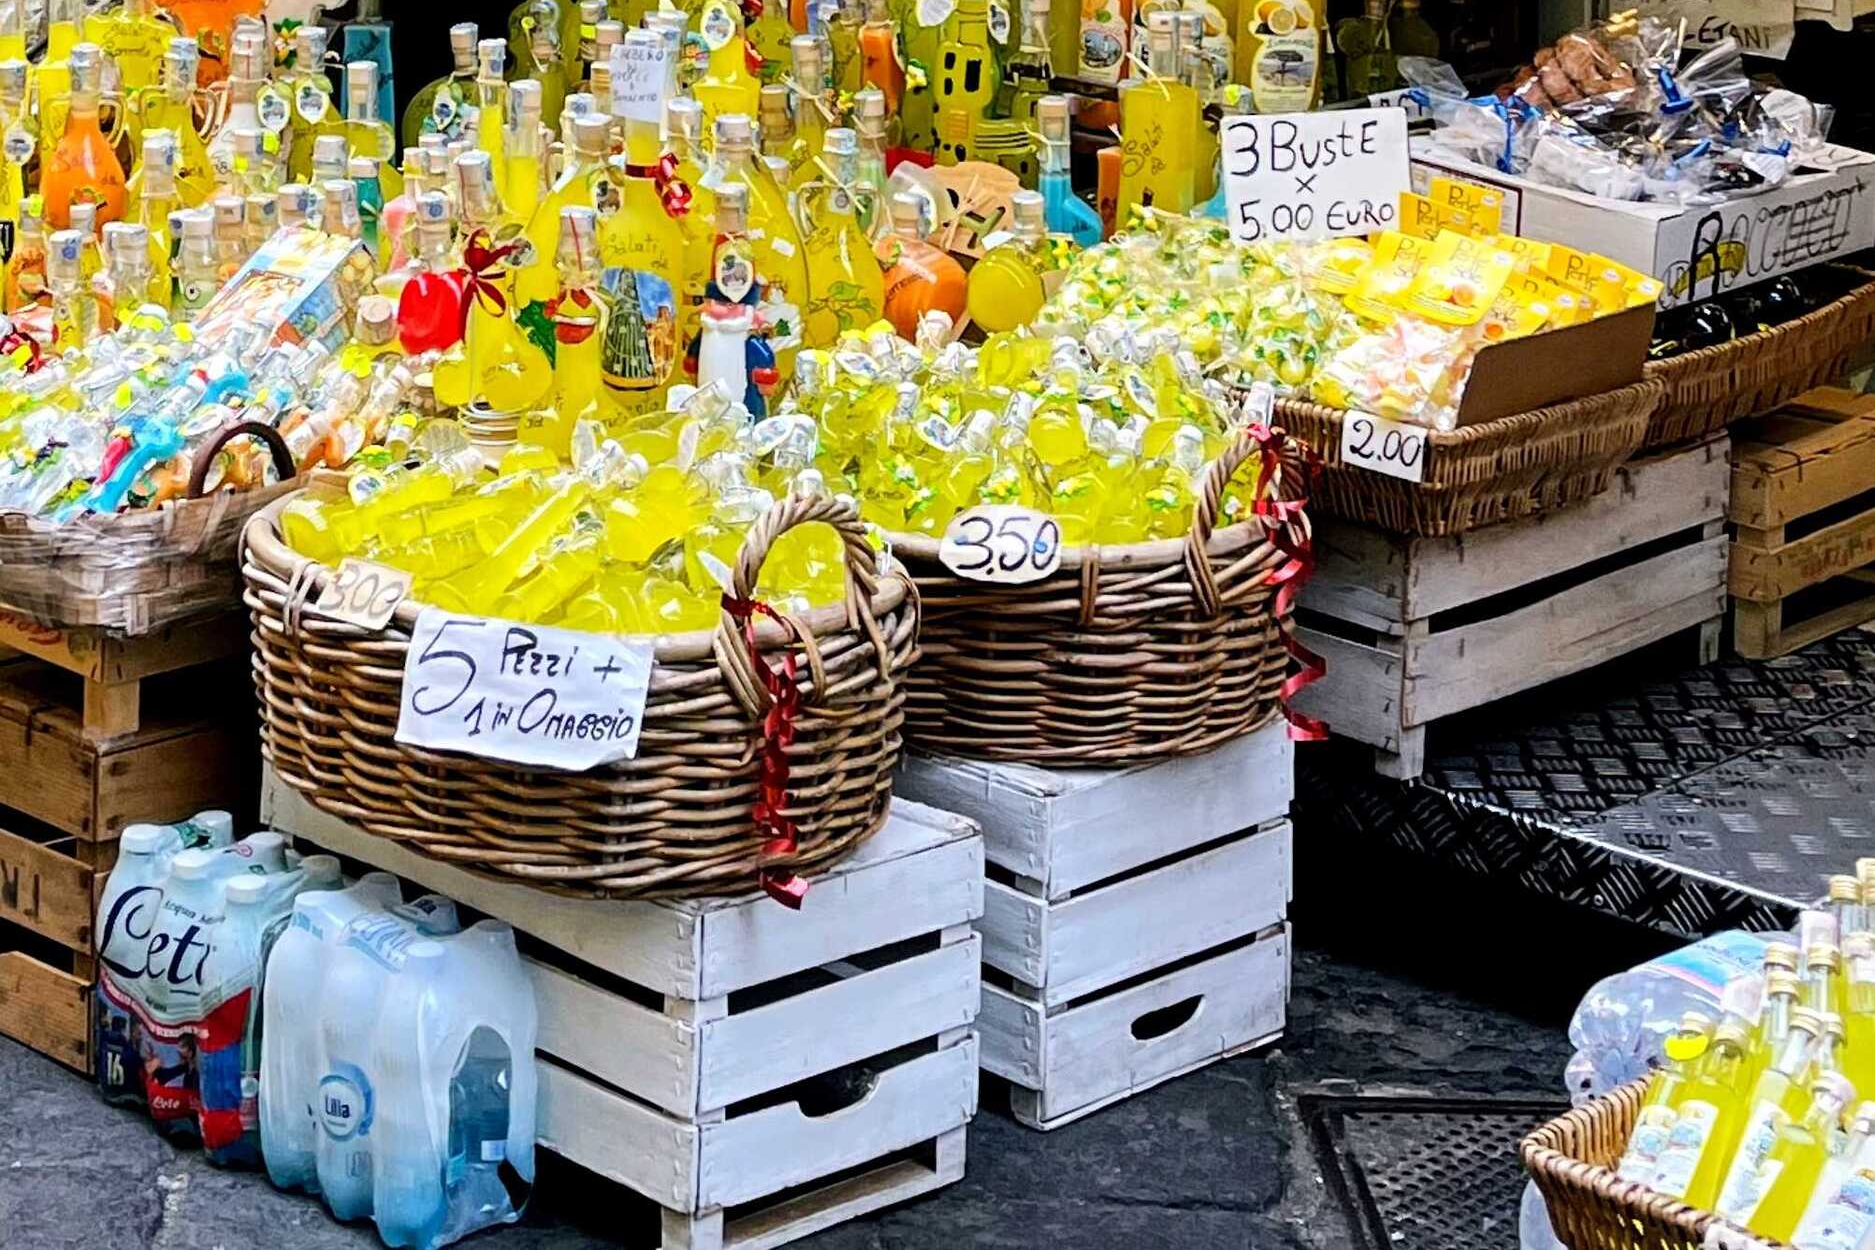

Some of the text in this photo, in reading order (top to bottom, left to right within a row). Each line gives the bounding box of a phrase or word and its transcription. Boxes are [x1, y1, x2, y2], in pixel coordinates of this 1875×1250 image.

[1228, 121, 1260, 177] 3
[1239, 199, 1314, 241] 5.00
[1349, 419, 1422, 467] 2.00
[954, 516, 1059, 575] 3.50
[412, 620, 487, 716] 5
[464, 697, 487, 737] 1
[107, 1051, 125, 1086] 16
